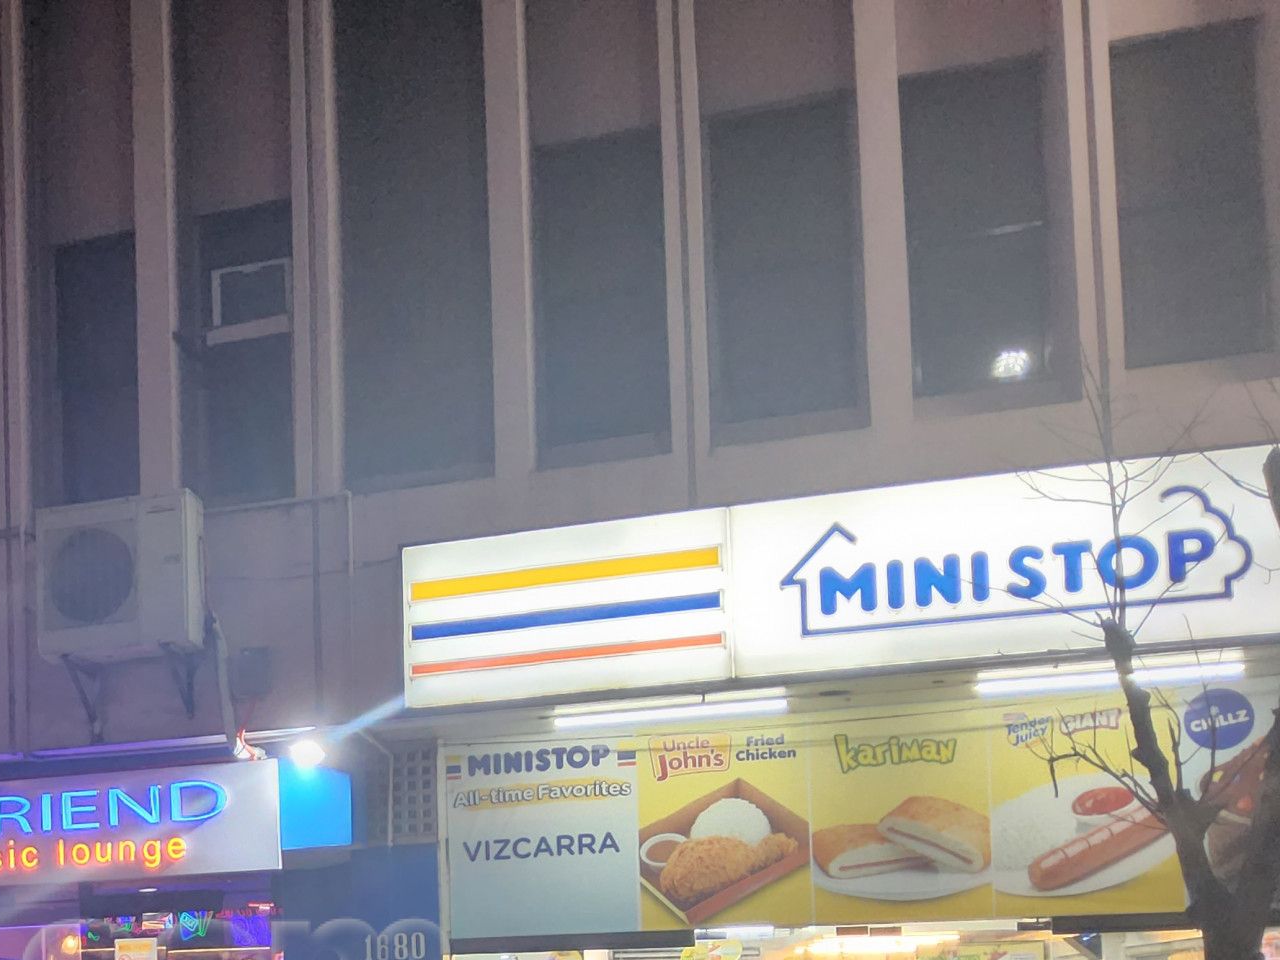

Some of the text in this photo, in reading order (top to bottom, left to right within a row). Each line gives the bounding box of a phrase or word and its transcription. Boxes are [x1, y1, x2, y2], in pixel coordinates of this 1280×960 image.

[819, 530, 1216, 614] MINISTOP
[1006, 716, 1052, 734] Tender
[1013, 726, 1049, 746] Juicy
[1059, 707, 1123, 736] GIANT
[663, 736, 711, 753] Uncle
[735, 748, 797, 762] Chicken
[746, 734, 786, 748] Fried
[467, 744, 611, 777] MINISTOP
[657, 748, 724, 781] John's
[454, 779, 632, 809] All-time Favorites
[57, 835, 188, 869] lounge
[462, 831, 621, 862] VIZCARRA
